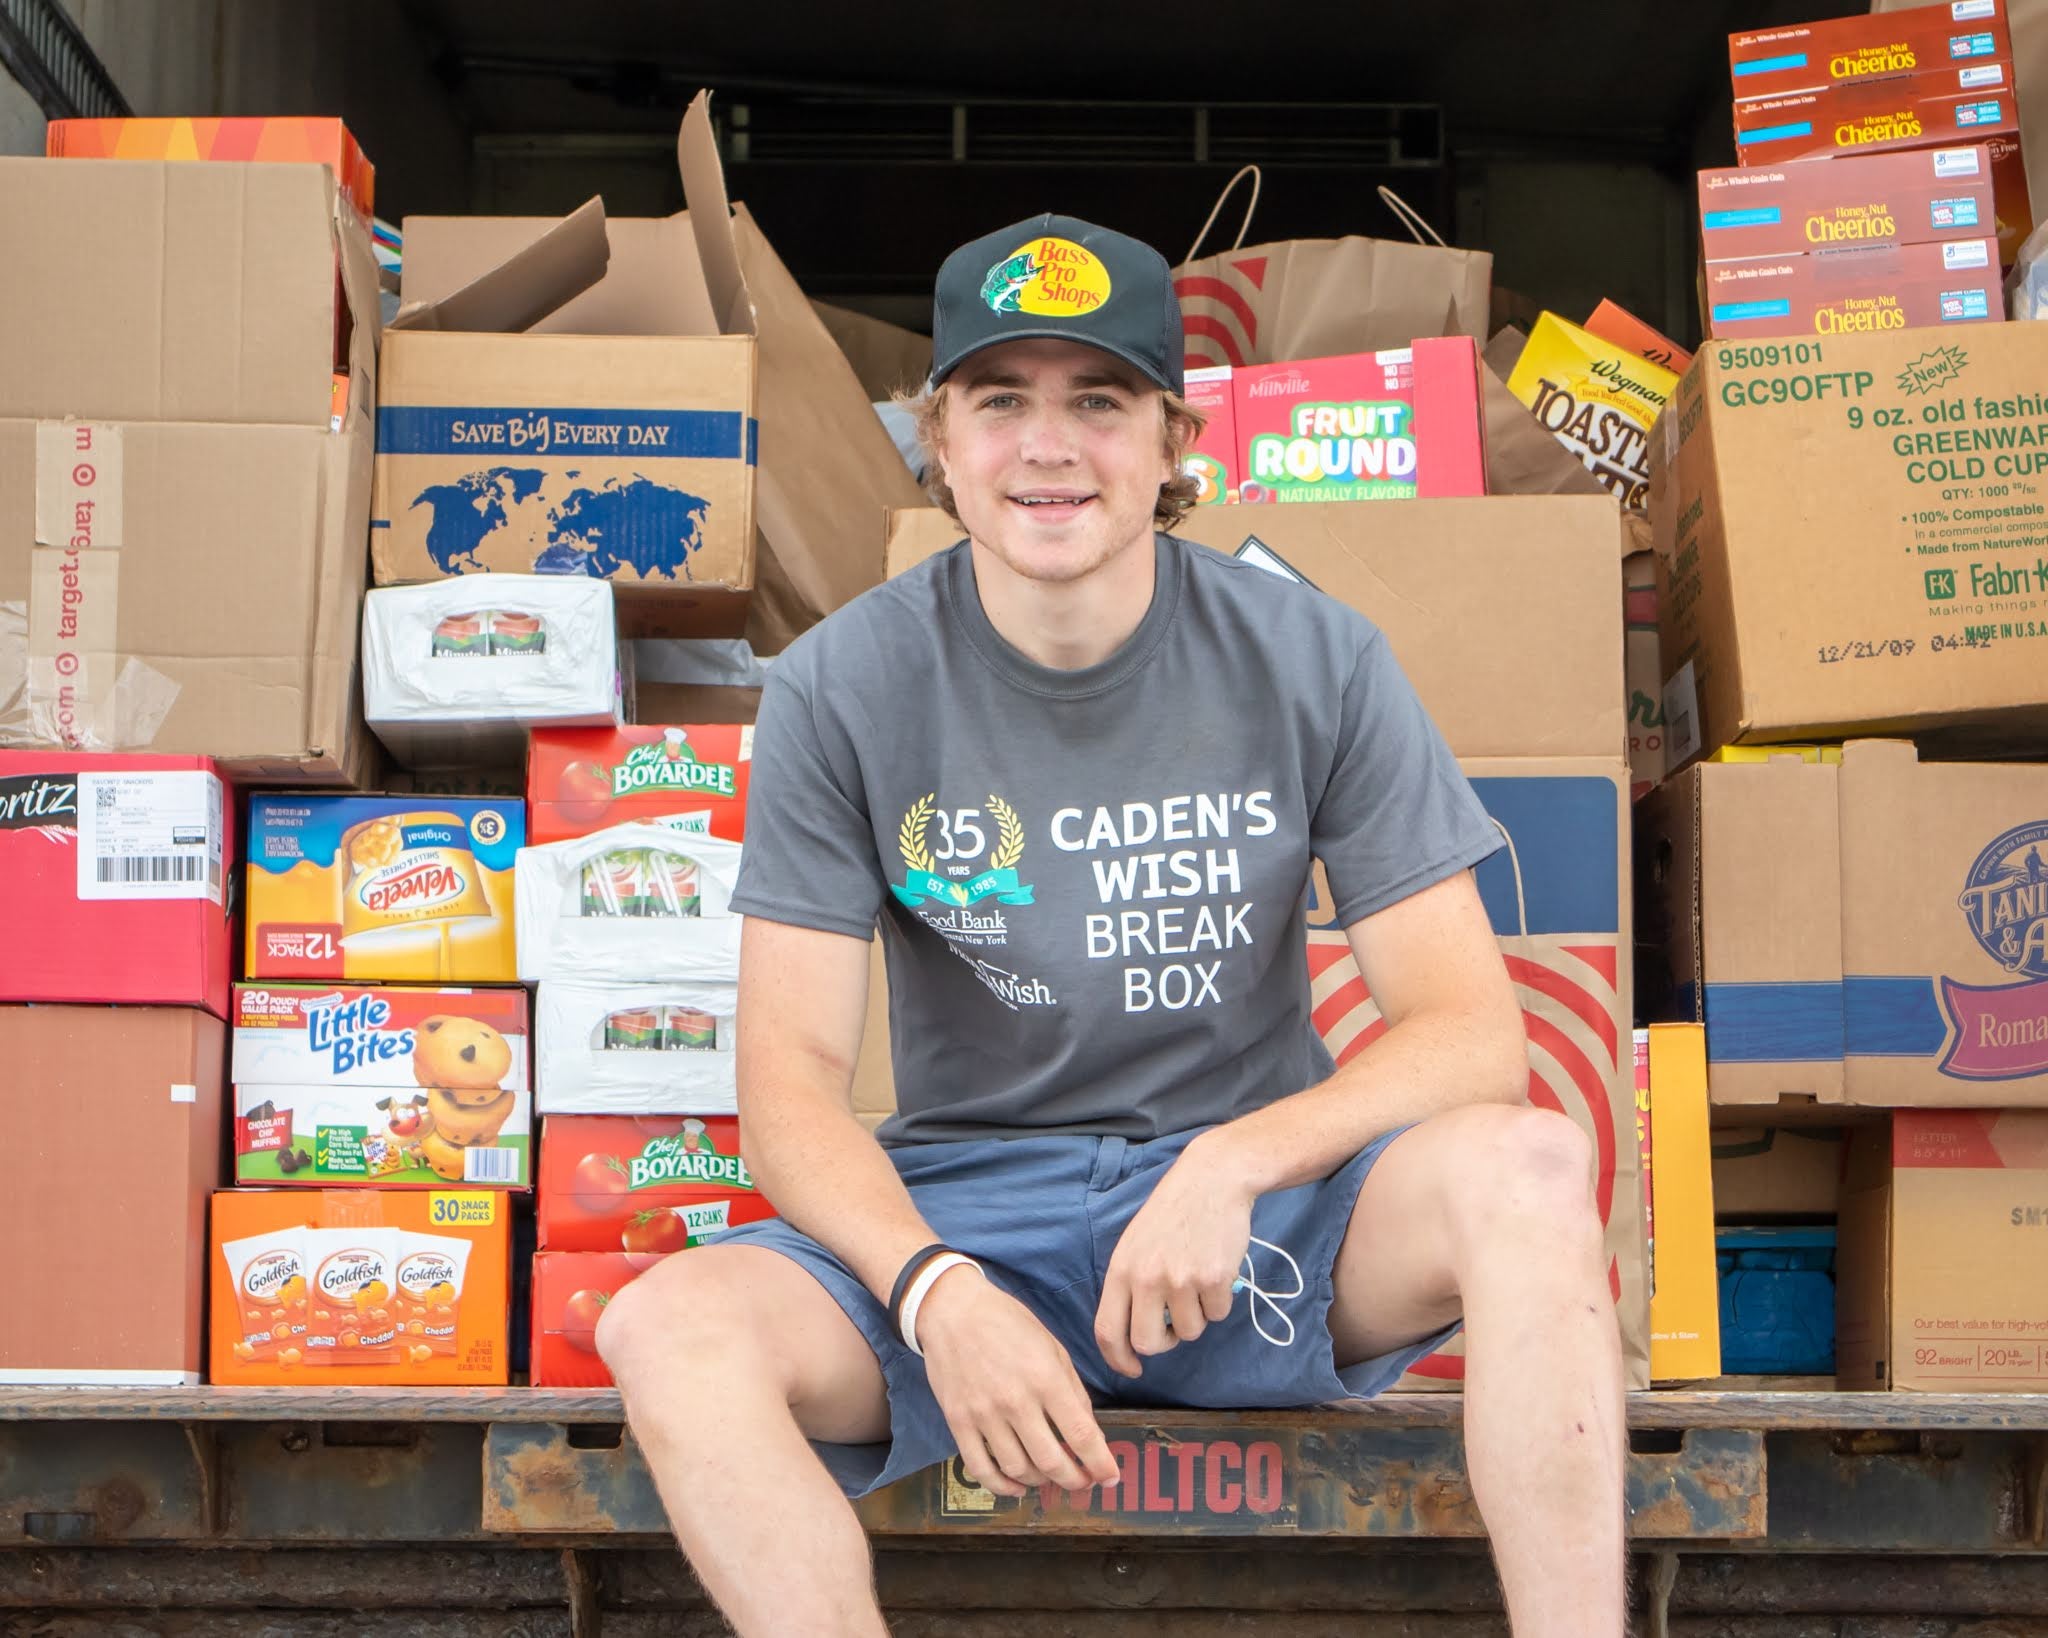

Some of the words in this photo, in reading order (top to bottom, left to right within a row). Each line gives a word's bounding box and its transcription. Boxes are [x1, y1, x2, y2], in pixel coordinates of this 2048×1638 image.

[1859, 46, 1888, 57] Honey
[1890, 43, 1908, 52] Nut
[1830, 51, 1916, 79] Cheerios
[1864, 114, 1893, 126] Honey
[1896, 110, 1914, 120] Nut
[1835, 119, 1922, 147] Cheerios
[1836, 206, 1866, 218] Honey
[1869, 203, 1888, 215] Nut
[1805, 215, 1896, 243] Cheerios
[1038, 239, 1090, 266] Bass
[1039, 262, 1077, 283] Pro
[1038, 281, 1101, 309] Shops
[1845, 298, 1875, 310] Honey
[1878, 295, 1897, 307] Nut
[1814, 308, 1906, 336] Cheerios
[1718, 342, 1824, 370] 9509101
[1912, 359, 1954, 385] New!
[1249, 377, 1311, 399] Millville
[1297, 405, 1402, 436] FRUIT
[1847, 406, 1864, 429] 9
[1873, 407, 1913, 428] oz.
[1922, 398, 1966, 424] old
[451, 420, 505, 444] SAVE
[507, 411, 550, 452] Big
[554, 421, 622, 446] EVERY
[628, 424, 671, 446] DAY
[1256, 437, 1416, 477] ROUND
[1907, 456, 1985, 484] COLD
[1280, 486, 1352, 503] NATURALLY
[1356, 485, 1417, 500] FLAVORE
[1942, 488, 1974, 501] QTY:
[1979, 485, 2009, 499] 1000
[1912, 511, 1949, 524] 100%
[1952, 503, 2045, 522] Compostable
[1939, 523, 2003, 538] commercial
[1917, 543, 1949, 556] Made
[1952, 540, 1980, 552] from
[1929, 604, 1984, 617] Making
[1990, 599, 2037, 613] things
[1965, 624, 1997, 642] MADE
[2000, 623, 2012, 638] IN
[1818, 639, 1916, 664] 12/21/09
[626, 745, 662, 766] Chef
[614, 762, 734, 795] BOYARDEE
[1050, 791, 1278, 852] CADEN'S
[407, 830, 452, 846] Original
[935, 808, 986, 860] 35
[947, 865, 971, 876] YEARS
[1091, 848, 1242, 904] WISH
[368, 865, 458, 912] Velveeta
[926, 878, 944, 896] EST.
[970, 876, 998, 897] 1985
[961, 909, 1007, 929] Bank
[965, 935, 984, 945] New
[987, 934, 1007, 946] York
[1084, 902, 1254, 959] BREAK
[267, 943, 305, 958] PACK
[305, 933, 336, 960] 12
[1999, 926, 2021, 958] &
[1123, 960, 1223, 1013] BOX
[242, 991, 270, 1005] 20
[269, 996, 299, 1006] POUCH
[241, 1005, 268, 1014] VALUE
[269, 1005, 294, 1014] PACK
[309, 996, 388, 1053] Little
[1976, 1012, 2048, 1048] Roma
[333, 1030, 415, 1075] Bites
[247, 1117, 286, 1131] CHOCOLATE
[259, 1128, 275, 1138] CHIP
[251, 1136, 282, 1149] MUFFINS
[644, 1136, 680, 1161] Chef
[631, 1153, 753, 1187] BOYARDEE
[434, 1199, 459, 1222] 30
[461, 1200, 490, 1210] SNACK
[461, 1211, 490, 1221] PACKS
[687, 1212, 702, 1228] 12
[702, 1209, 724, 1226] CANS
[249, 1257, 299, 1292] Goldfish
[323, 1261, 383, 1290] Goldfish
[401, 1265, 454, 1283] Goldfish
[425, 1325, 455, 1336] Cheddar
[1914, 1318, 1935, 1329] Our
[1936, 1319, 1960, 1329] best
[1962, 1319, 1990, 1330] value
[1991, 1319, 2006, 1330] for
[360, 1329, 395, 1346] Cheddar
[1915, 1348, 1937, 1366] 92
[1939, 1357, 1973, 1366] BRIGHT
[1984, 1349, 2007, 1366] 20
